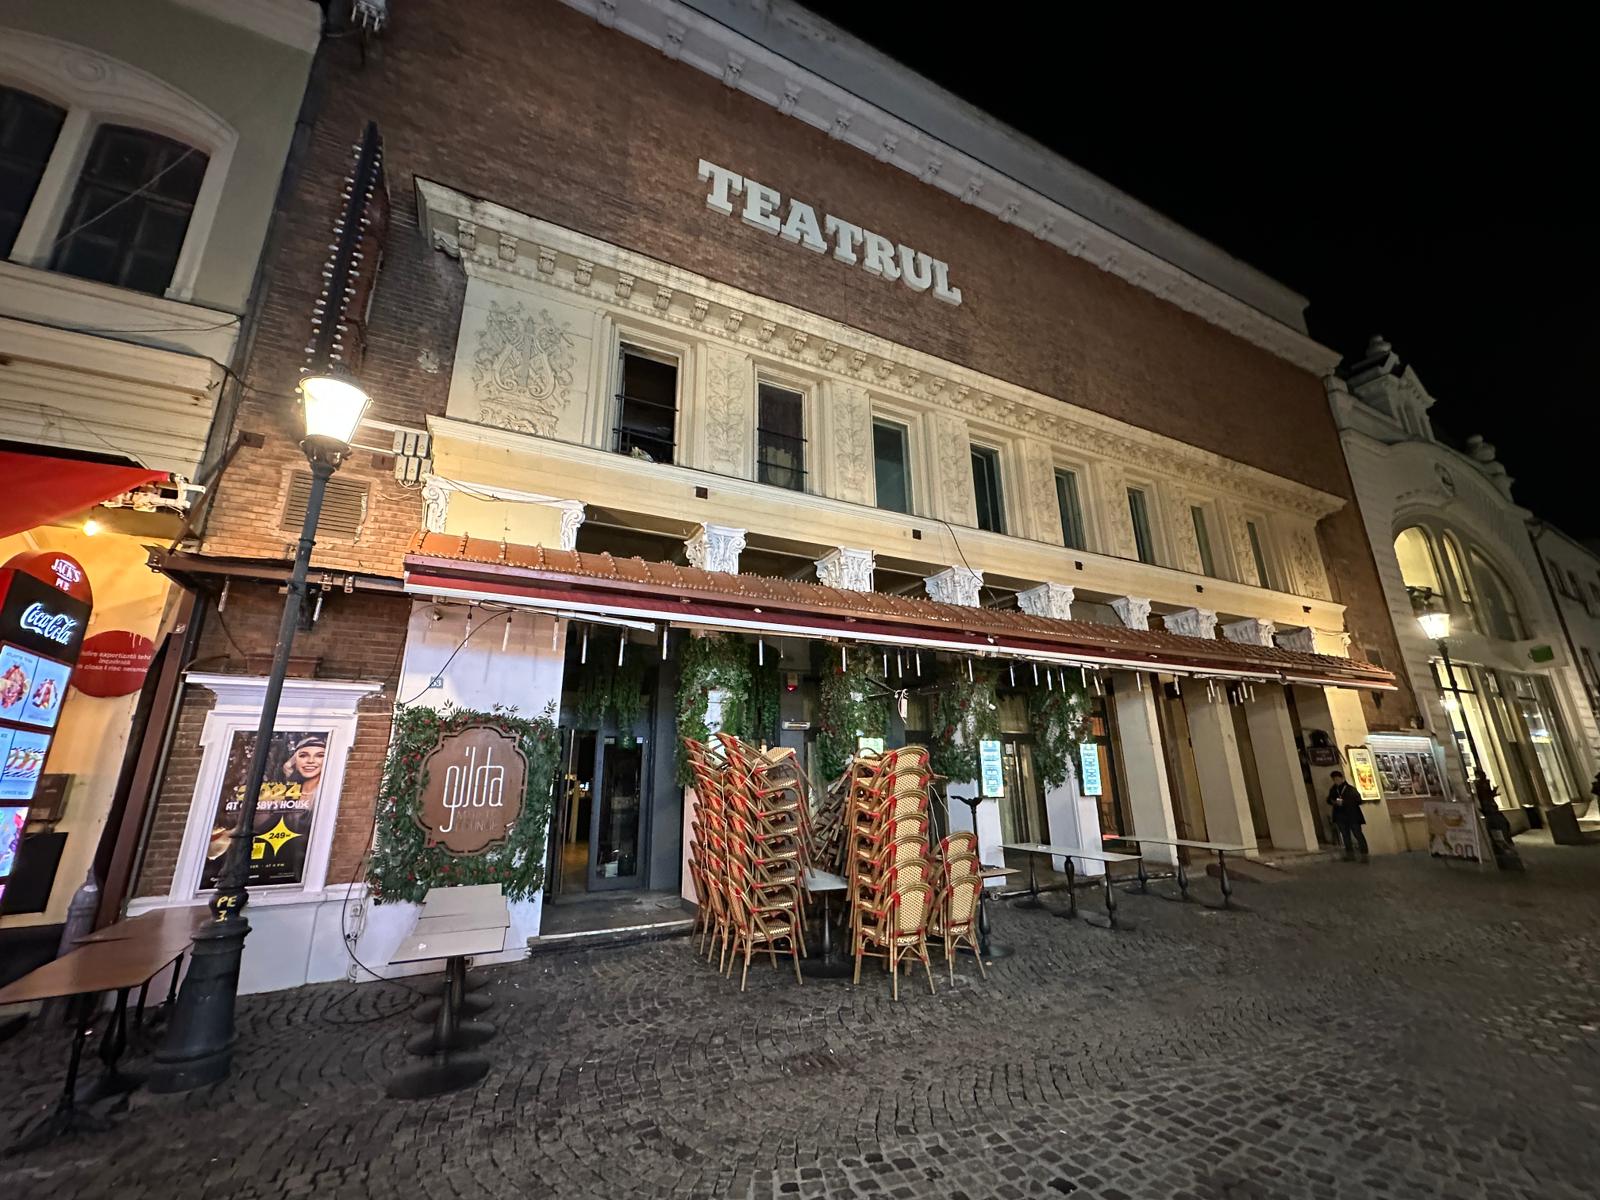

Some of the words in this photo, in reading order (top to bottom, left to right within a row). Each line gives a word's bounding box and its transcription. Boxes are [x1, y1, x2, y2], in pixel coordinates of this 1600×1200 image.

[698, 158, 962, 306] TEATRUL
[51, 558, 81, 582] JACK'S
[440, 746, 504, 832] gilda
[225, 801, 238, 811] AT
[280, 800, 309, 809] HOUSE
[268, 832, 286, 840] 249
[217, 895, 237, 908] PE
